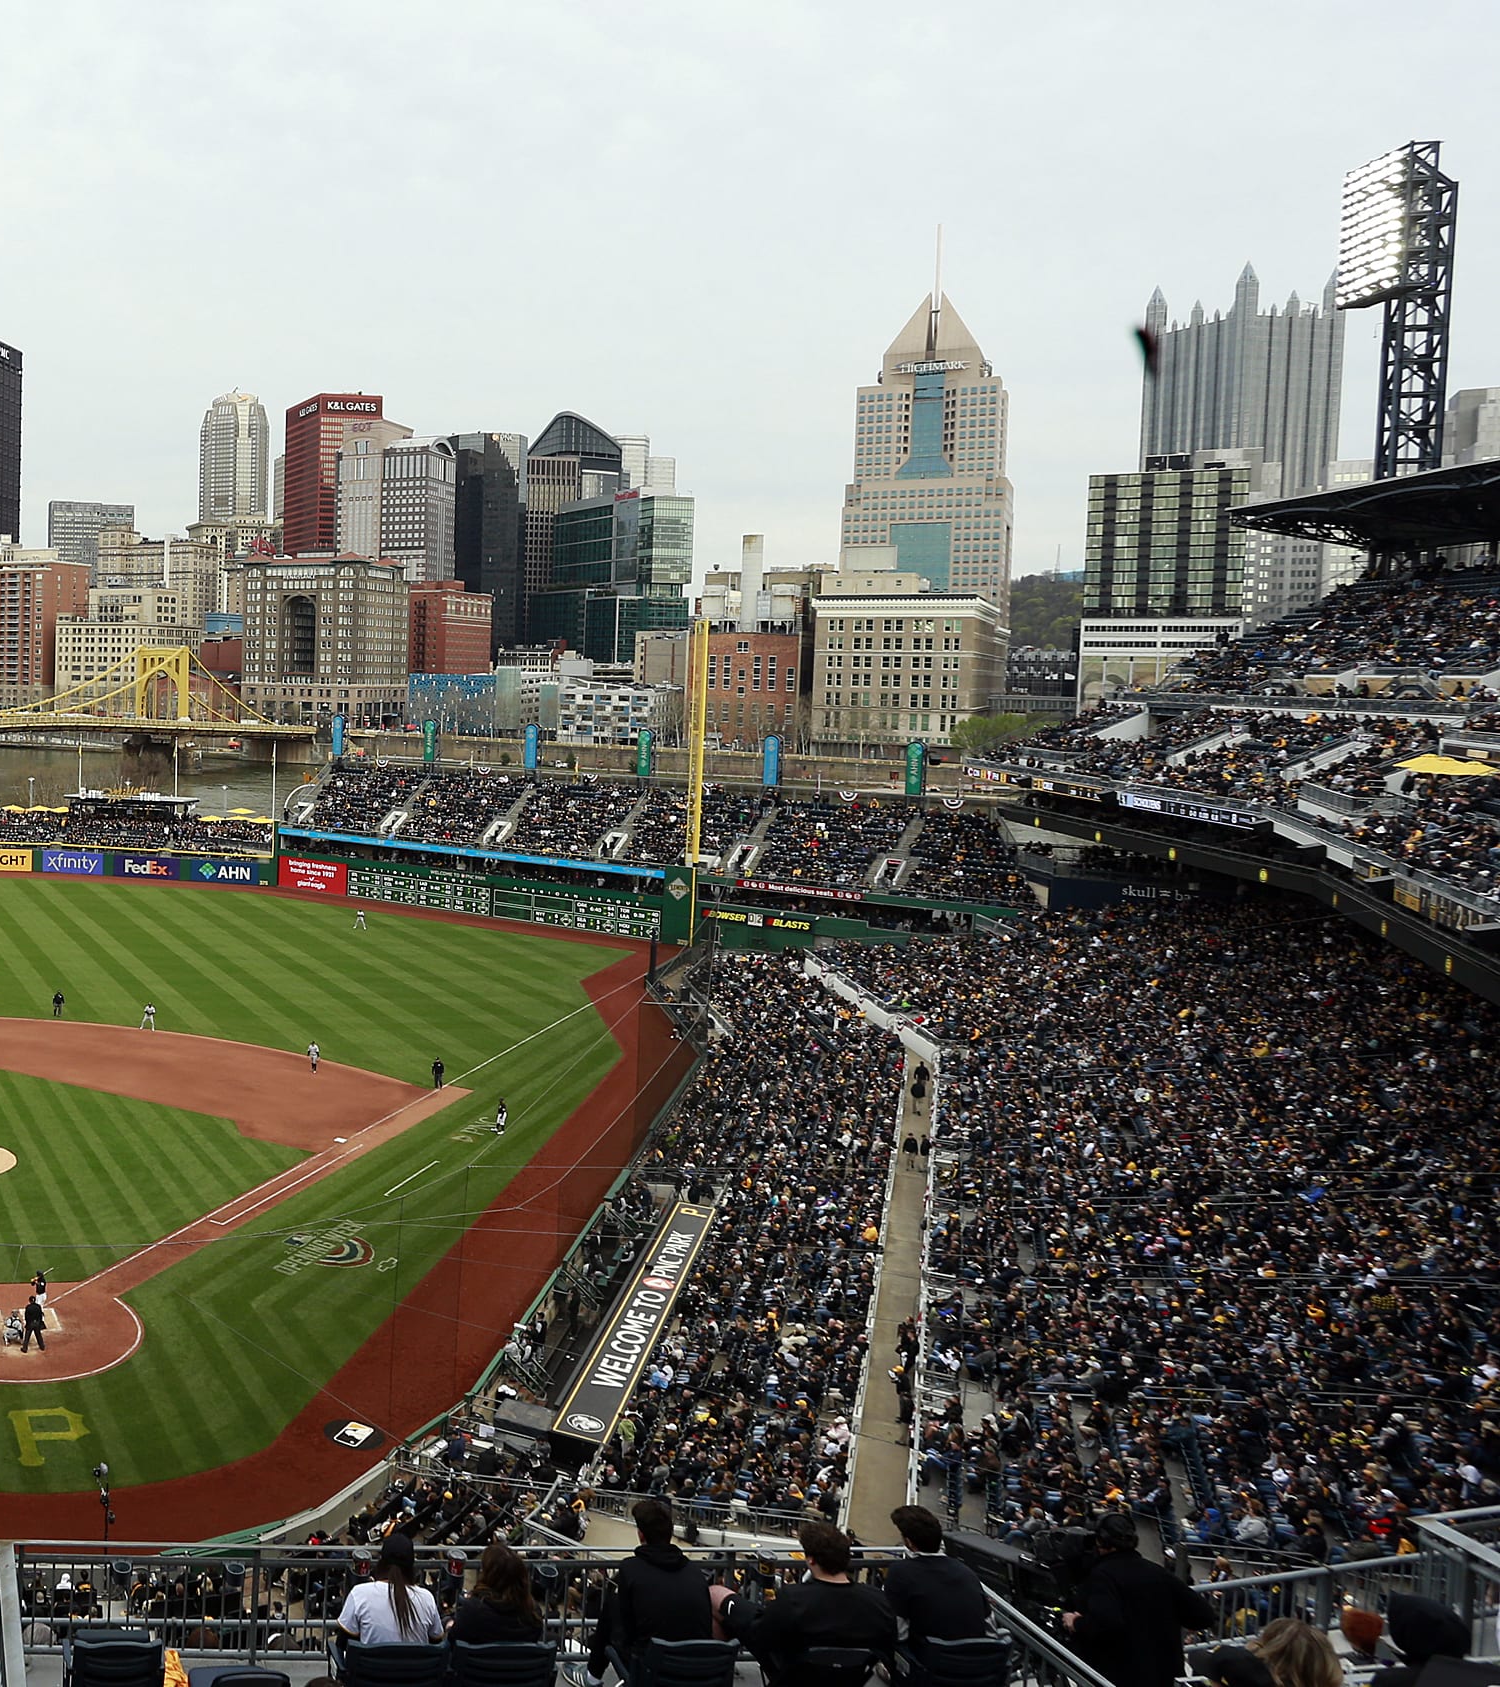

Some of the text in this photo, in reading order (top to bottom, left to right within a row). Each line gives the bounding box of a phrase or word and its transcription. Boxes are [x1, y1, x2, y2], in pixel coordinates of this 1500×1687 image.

[901, 361, 965, 373] HIGHMARK
[327, 401, 377, 412] K&L GATES
[140, 792, 161, 802] TIME
[48, 853, 98, 873] xfinity
[124, 859, 168, 876] FedEx
[288, 860, 338, 872] bringing freshness
[217, 866, 250, 880] AHN
[306, 868, 322, 877] since
[513, 886, 640, 907] AMERICAN LEAGUE
[768, 884, 834, 898] Most delicious seats
[1122, 885, 1156, 898] skull
[709, 910, 746, 922] BOWSER
[772, 918, 810, 931] BLASTS
[680, 1208, 708, 1218] P
[272, 1219, 367, 1276] OPENING WEEK
[591, 1230, 695, 1388] WELCOME TO PNC PARK
[7, 1406, 91, 1467] P
